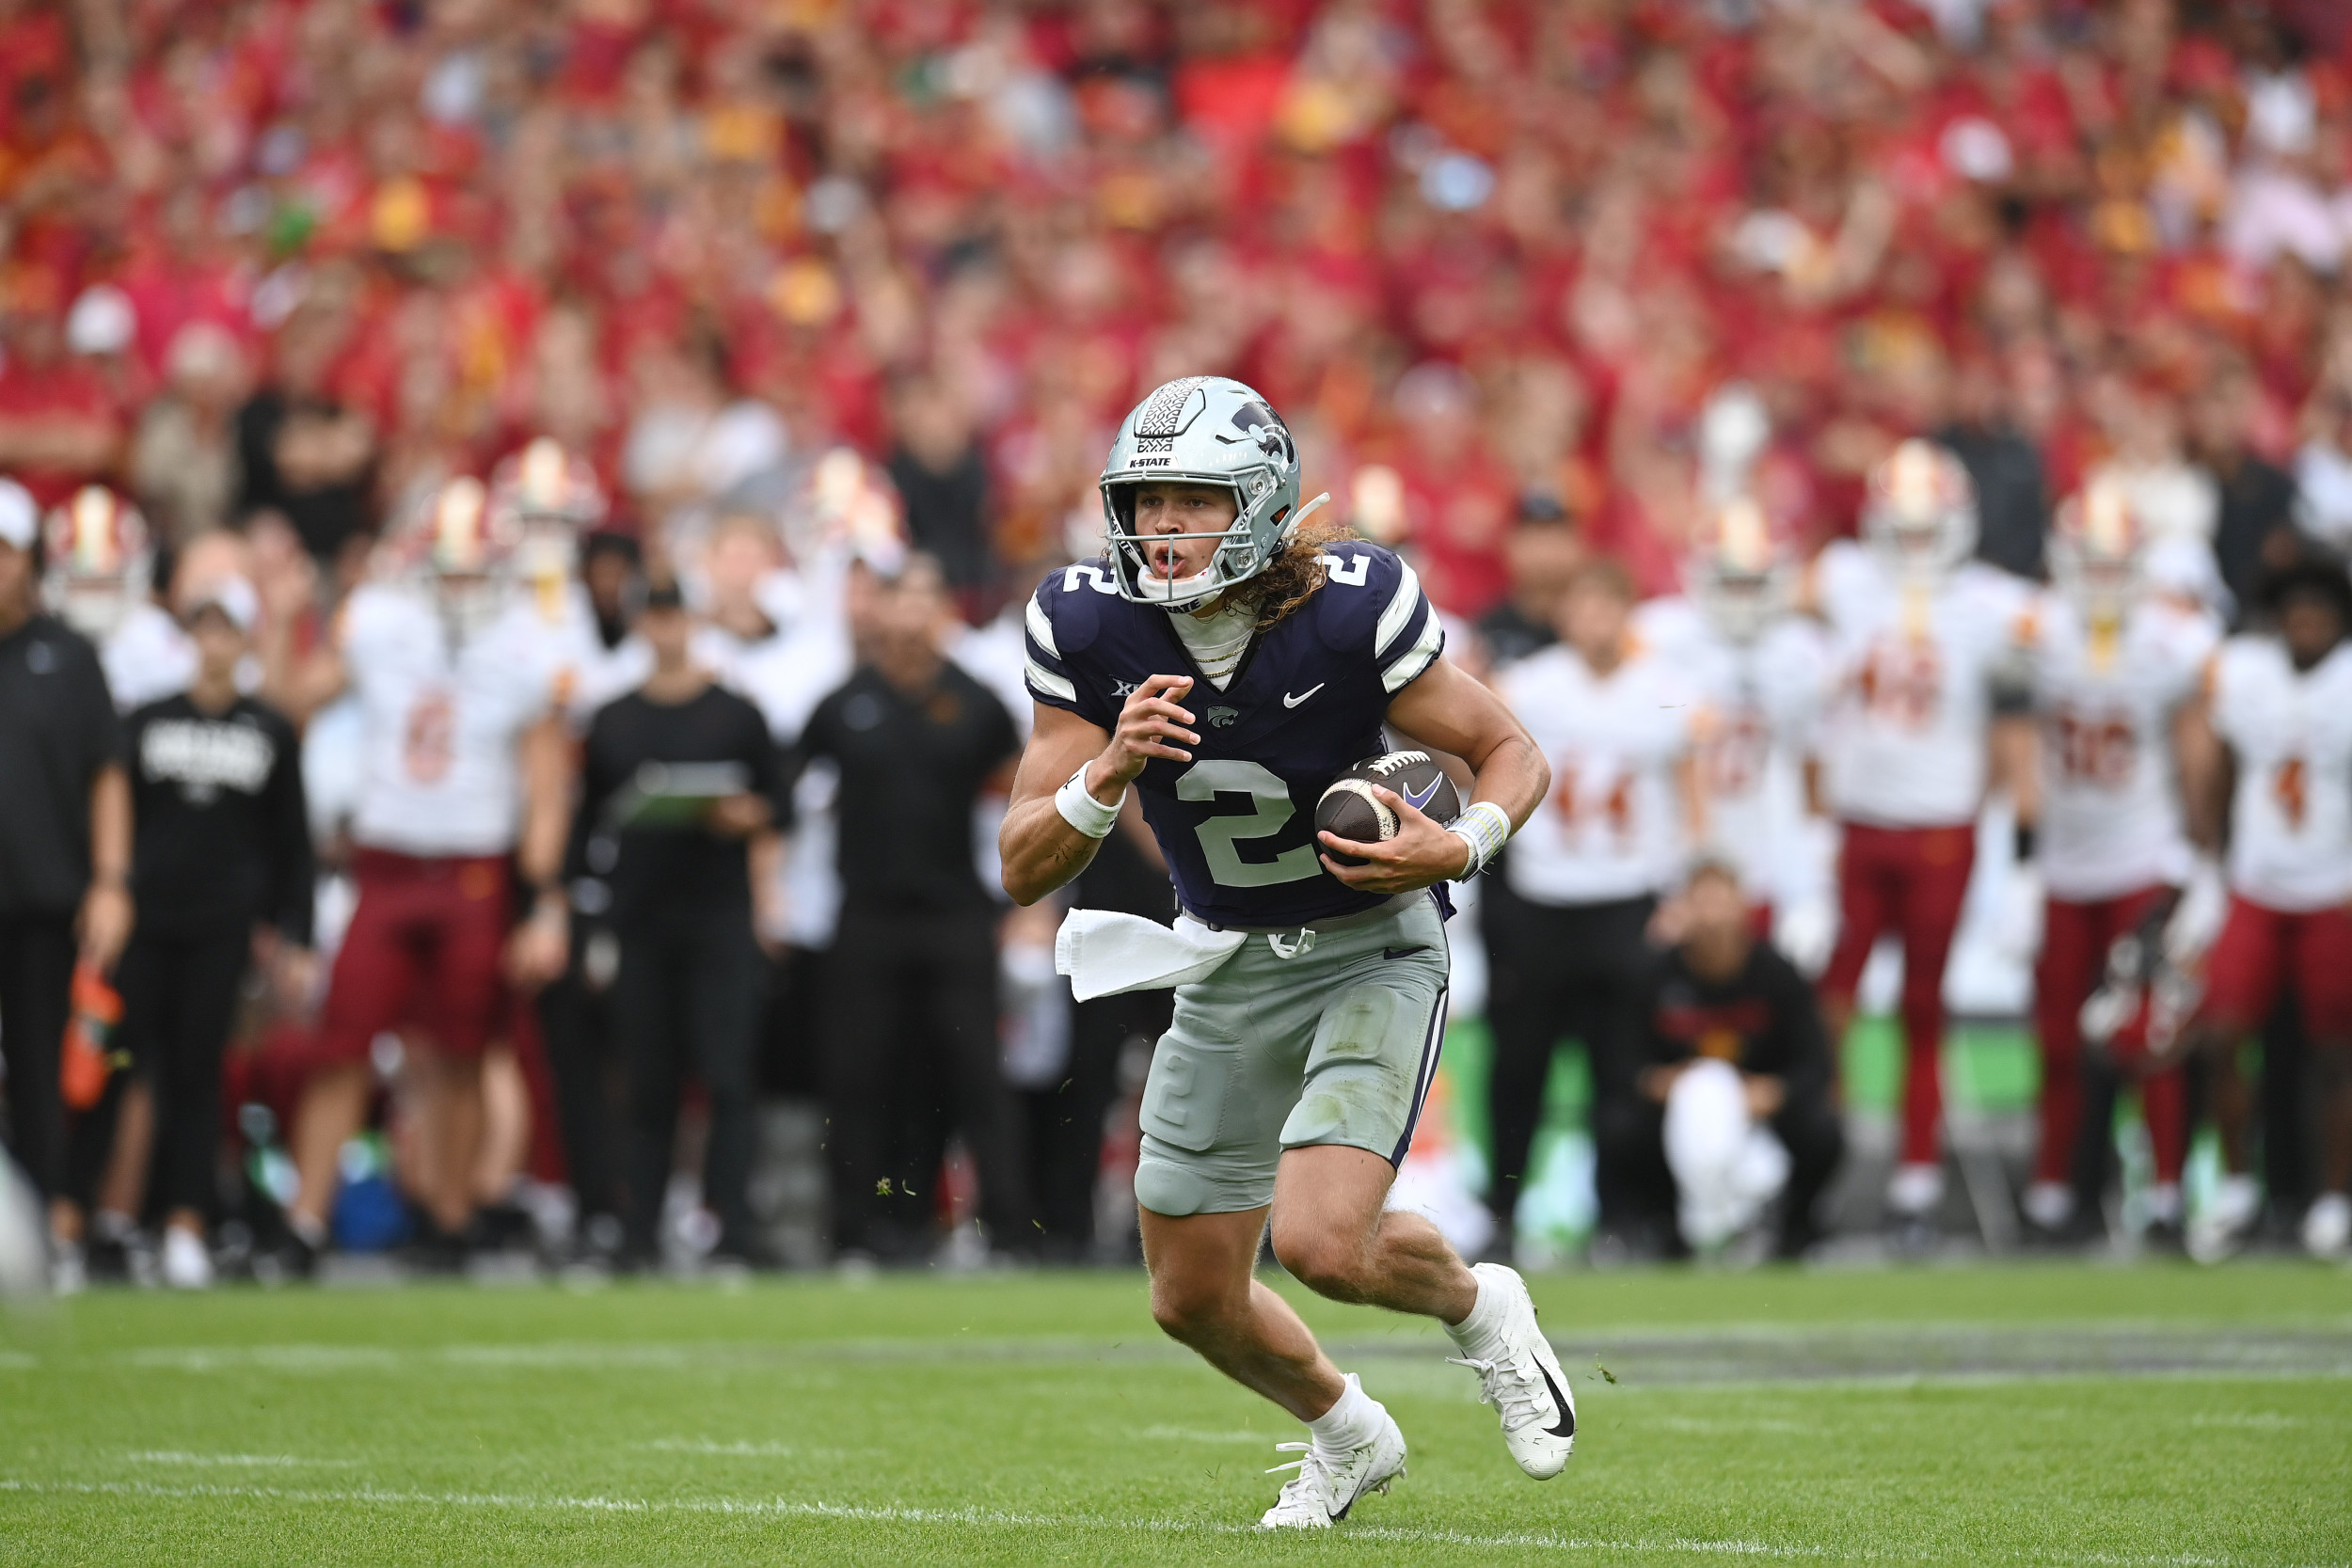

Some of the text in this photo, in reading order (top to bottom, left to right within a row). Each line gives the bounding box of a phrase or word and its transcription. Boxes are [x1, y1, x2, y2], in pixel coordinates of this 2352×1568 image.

[1129, 457, 1171, 468] K-STATE
[1111, 516, 1134, 554] K-STTE
[1063, 564, 1119, 594] 2
[1311, 553, 1371, 587] 2
[1175, 759, 1323, 887] 2
